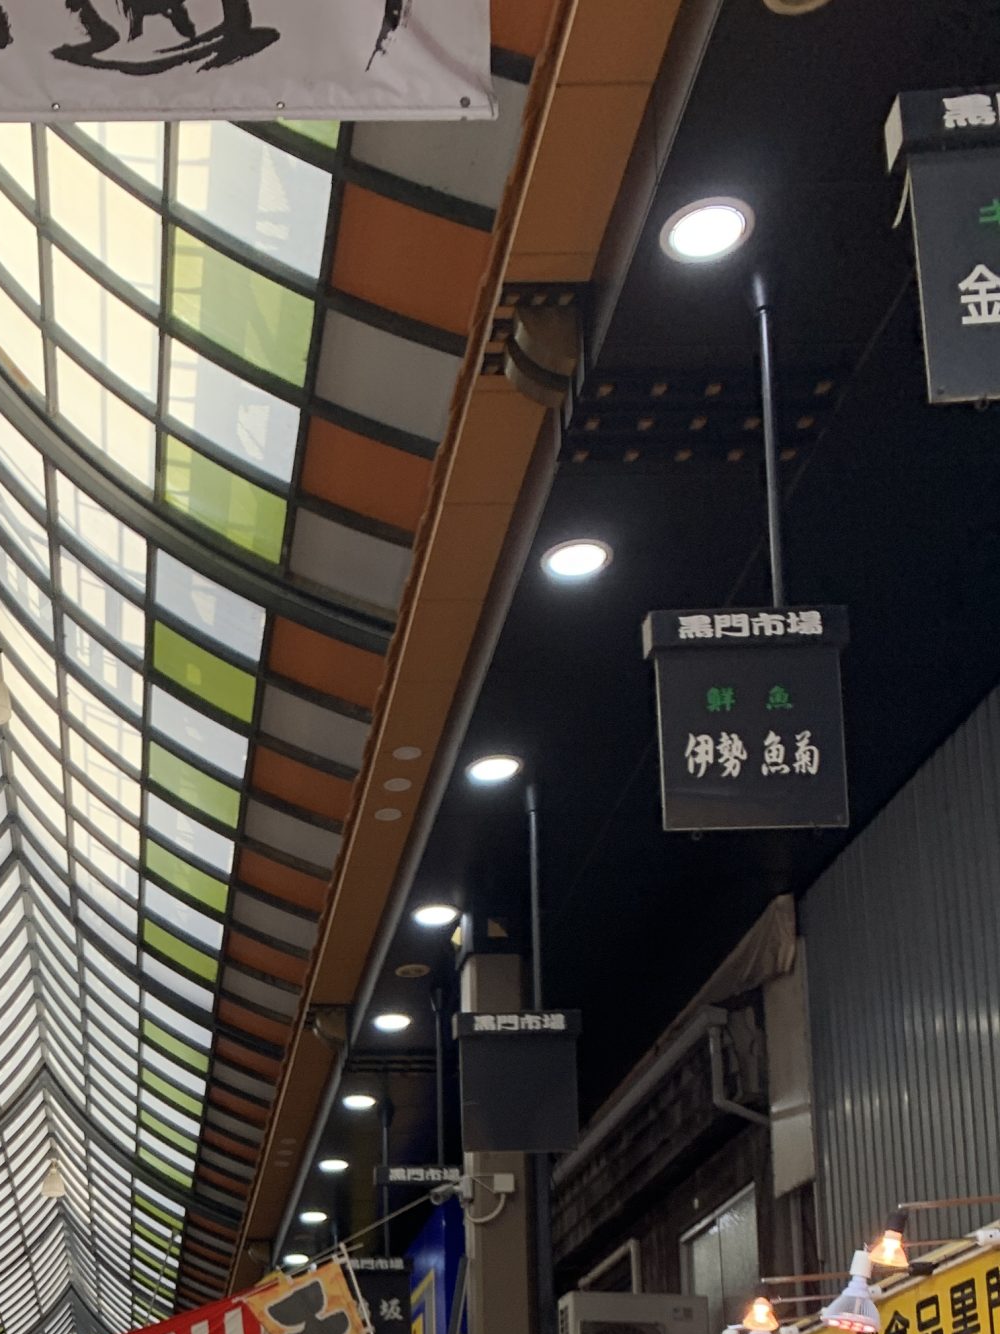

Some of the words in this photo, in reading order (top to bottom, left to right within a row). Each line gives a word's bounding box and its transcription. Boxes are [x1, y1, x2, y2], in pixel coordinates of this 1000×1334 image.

[942, 93, 1000, 129] 黒
[677, 610, 823, 639] 黒門市場
[706, 685, 793, 712] 鮮魚
[473, 1013, 566, 1031] 黒門市場
